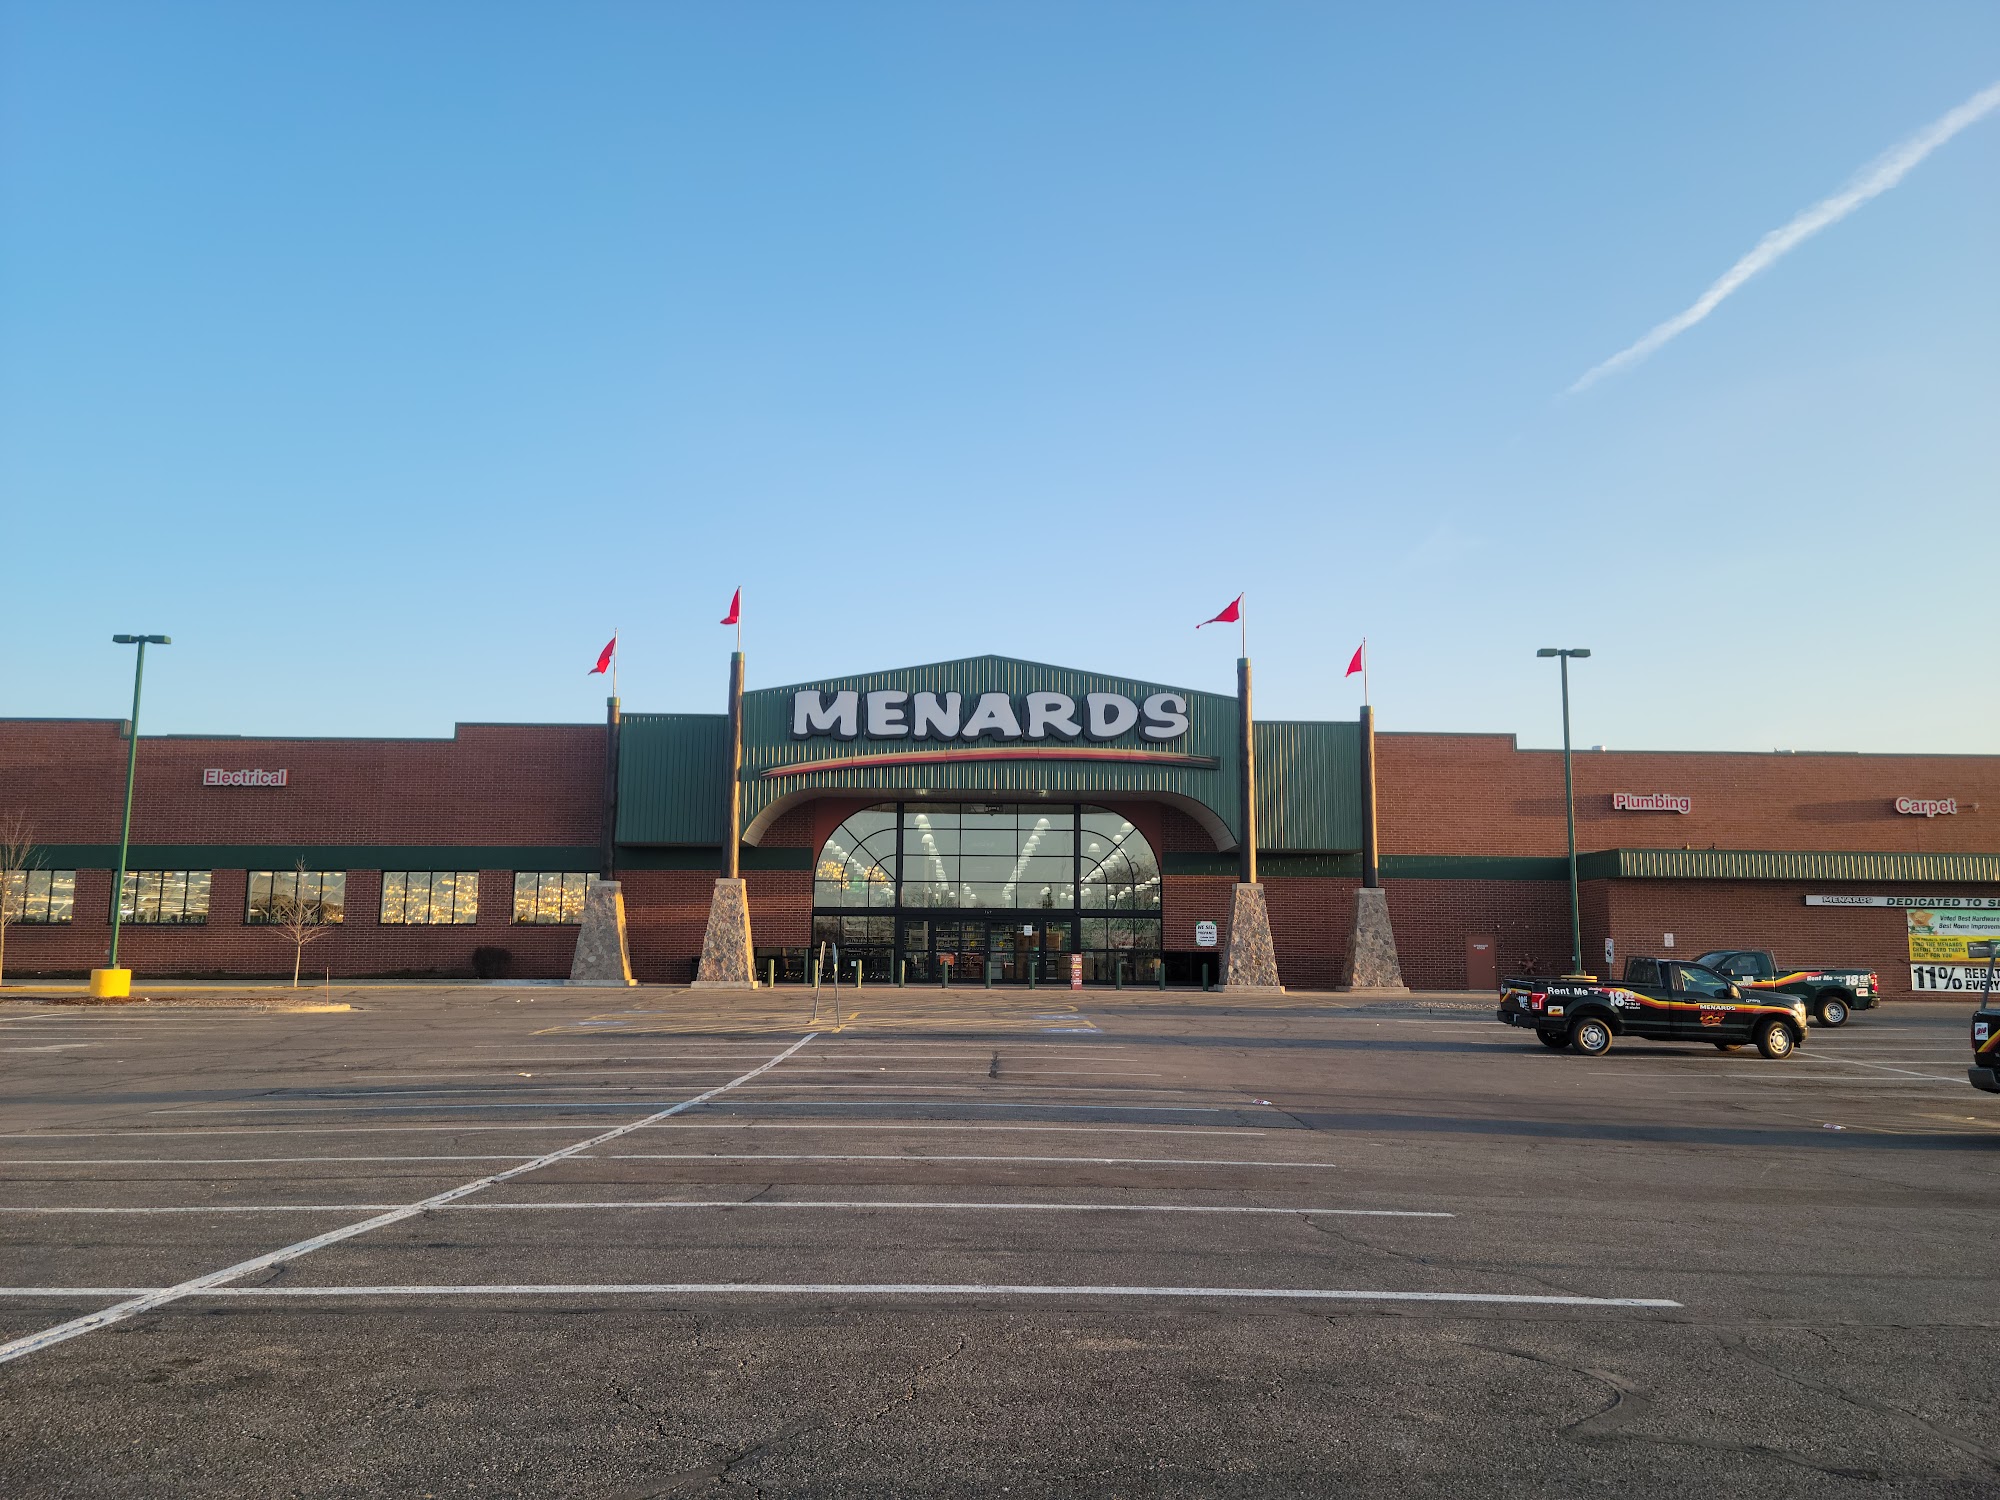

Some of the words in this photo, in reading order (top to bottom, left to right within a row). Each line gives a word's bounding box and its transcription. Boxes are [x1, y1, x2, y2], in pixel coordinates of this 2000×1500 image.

[791, 690, 1190, 741] MENARDS
[204, 769, 287, 785] Electrical
[1614, 793, 1690, 813] Plumbing
[1896, 797, 1957, 817] Carpet
[1822, 896, 1873, 904] MENARDS
[1886, 898, 1961, 907] DEDICATED
[1966, 899, 1982, 907] TO
[1845, 975, 1858, 986] 18
[1913, 966, 1962, 989] 11%
[1547, 987, 1570, 995] Rent
[1573, 988, 1588, 996] Me
[1608, 991, 1625, 1007] 18
[1625, 991, 1635, 999] 95
